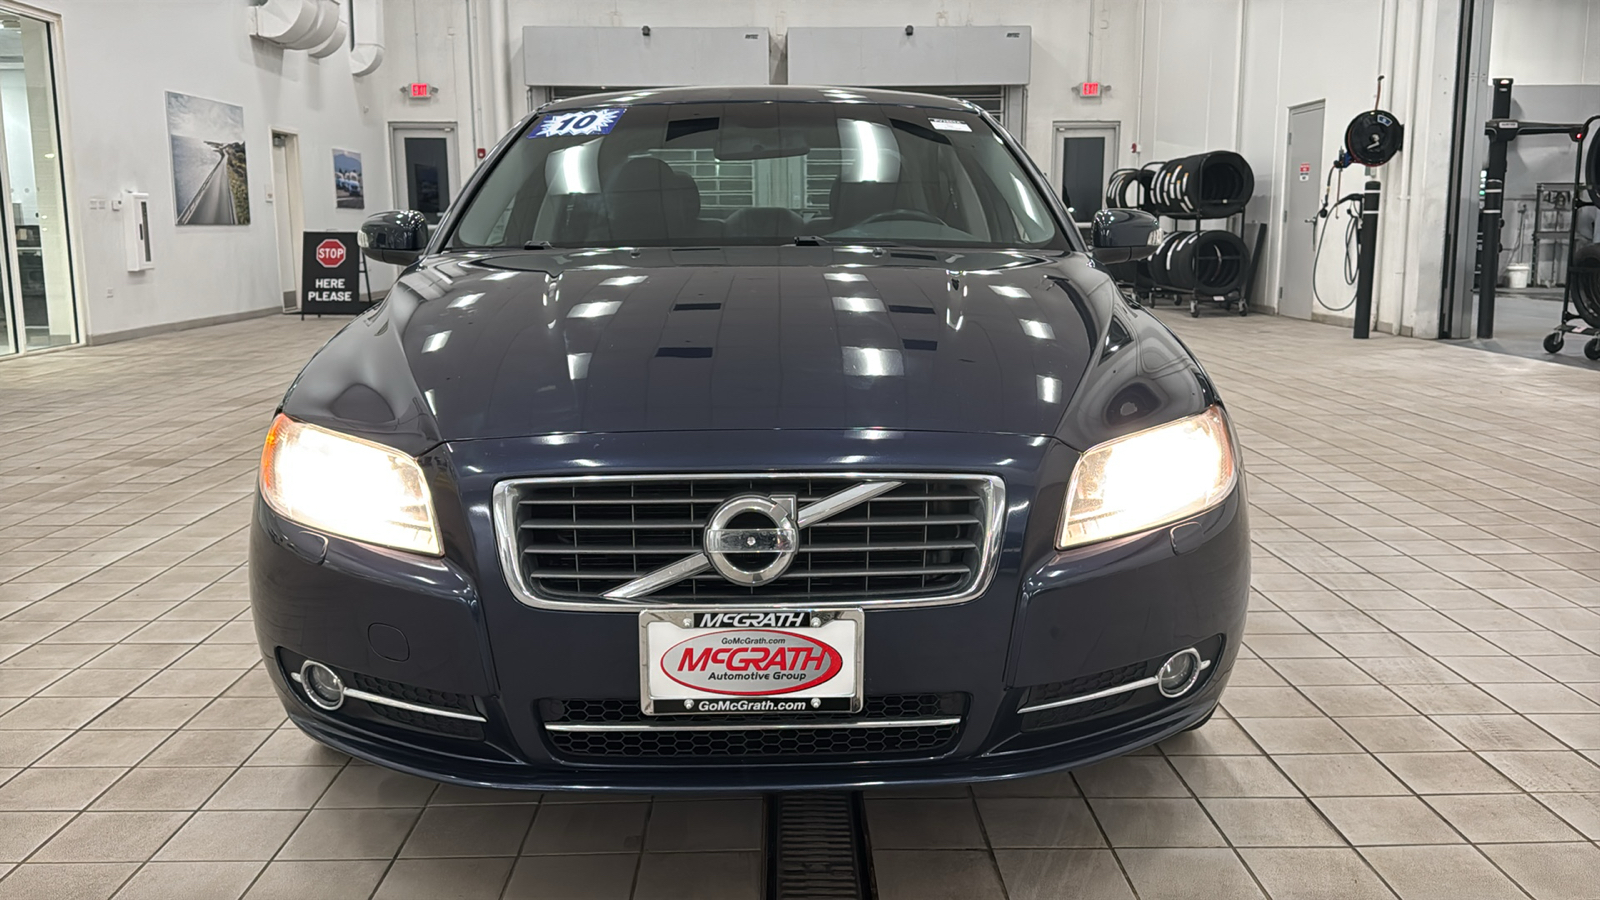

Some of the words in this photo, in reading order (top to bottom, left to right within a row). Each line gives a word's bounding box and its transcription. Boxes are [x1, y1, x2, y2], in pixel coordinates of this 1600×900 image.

[557, 115, 598, 131] 10
[318, 248, 344, 258] STOP
[315, 278, 345, 288] HERE
[308, 291, 352, 301] PLEASE
[721, 637, 786, 645] GoMcGrath.com
[707, 671, 770, 681] Automotive
[772, 671, 807, 682] Group
[698, 700, 806, 712] GoMcGrath.com
